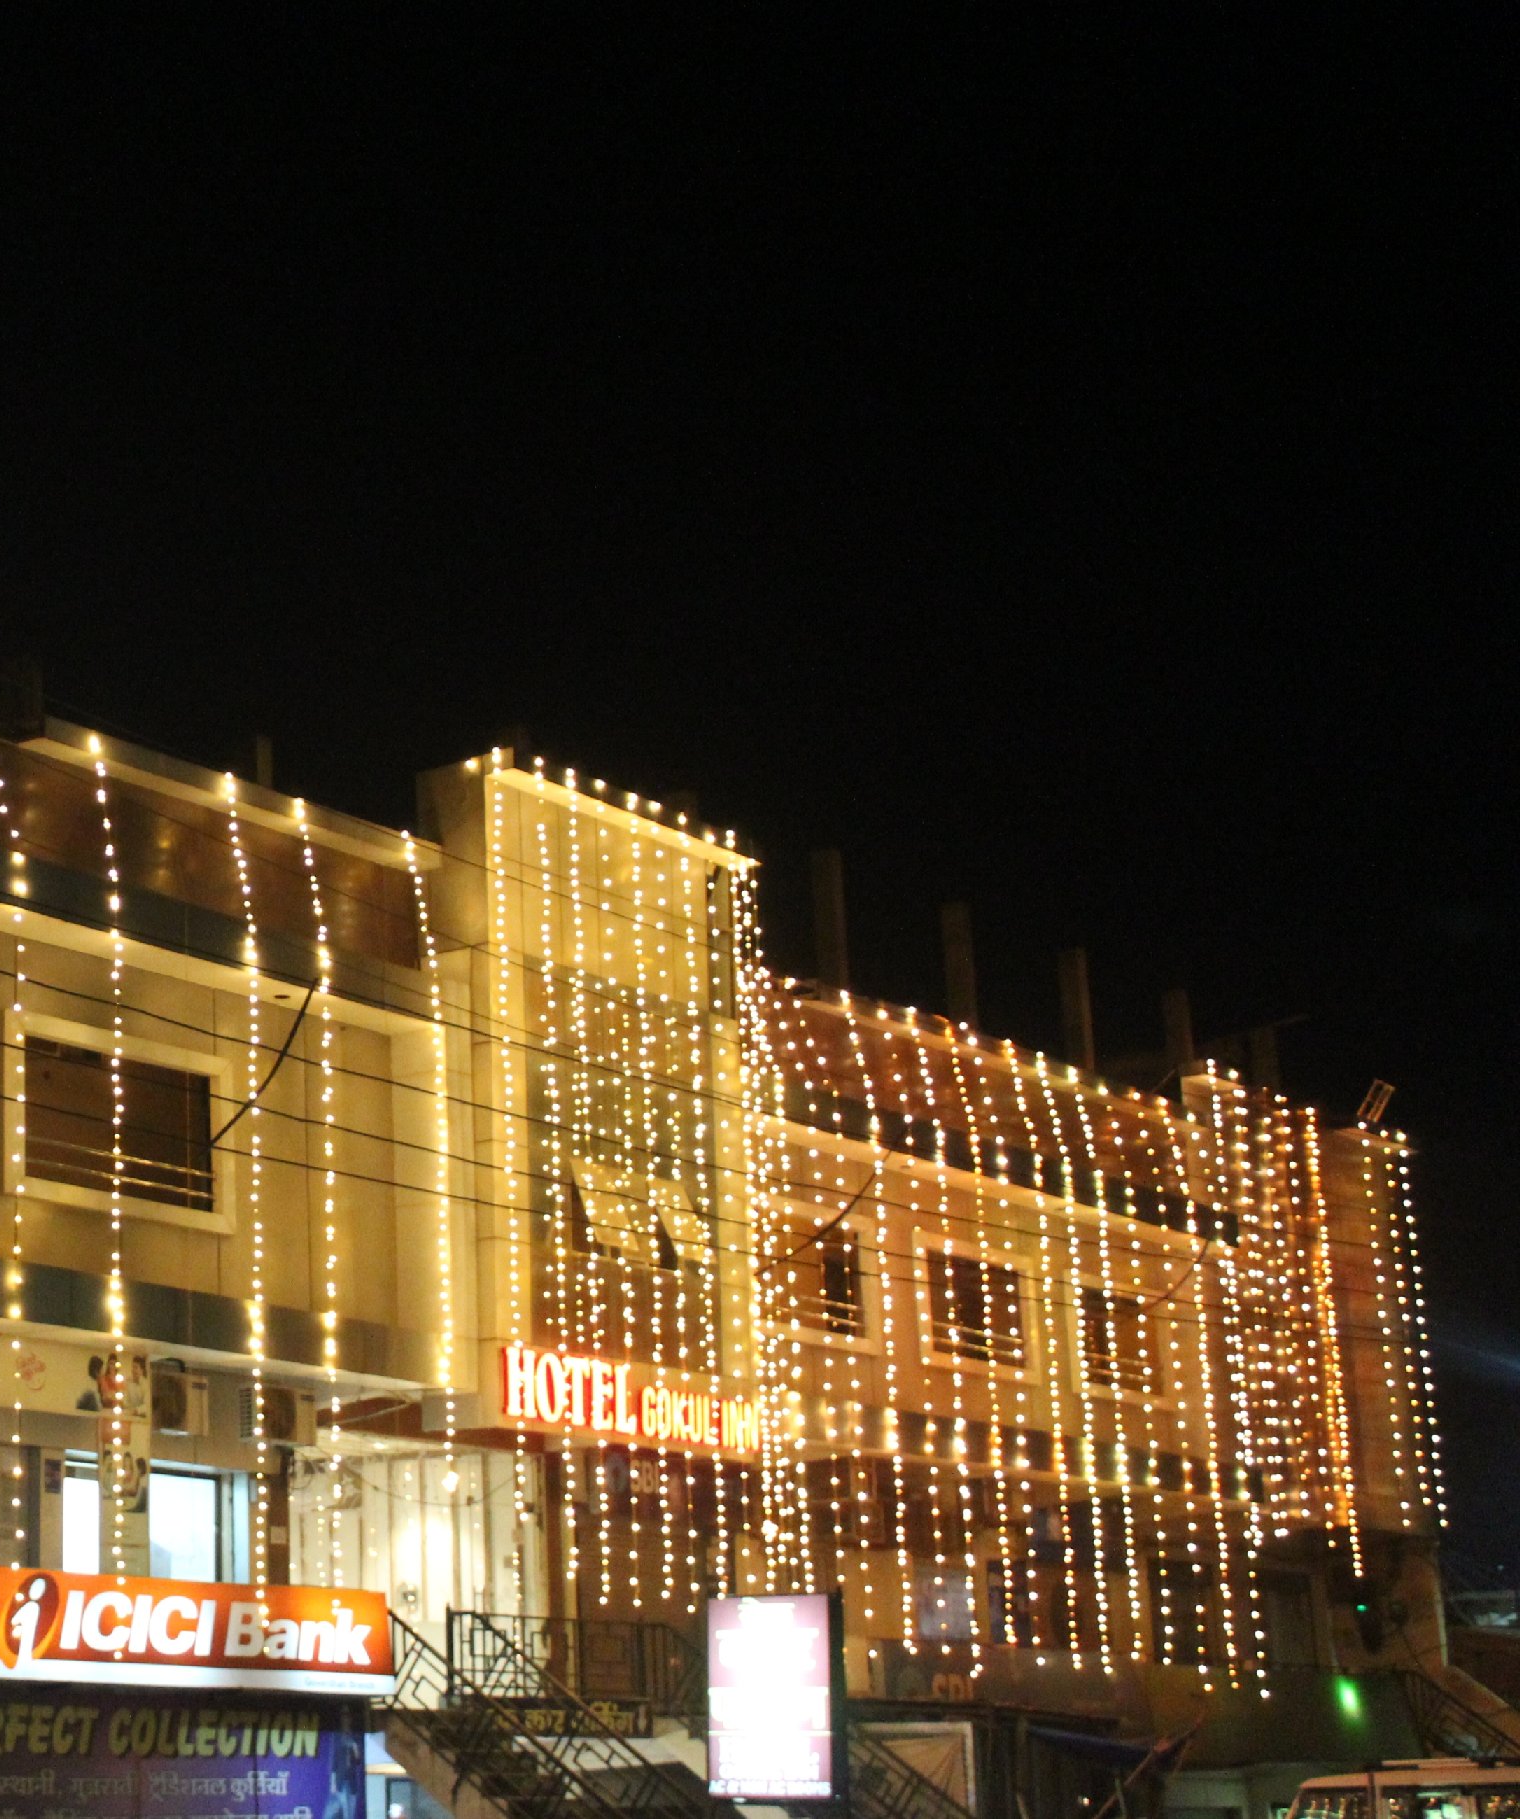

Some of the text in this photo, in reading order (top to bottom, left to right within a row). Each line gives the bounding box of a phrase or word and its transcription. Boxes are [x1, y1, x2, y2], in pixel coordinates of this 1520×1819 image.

[504, 1346, 761, 1451] HOTEL GOKUL INN
[59, 1589, 217, 1656] ICICI
[224, 1601, 372, 1666] Bank
[108, 1707, 319, 1757] COLLECTION
